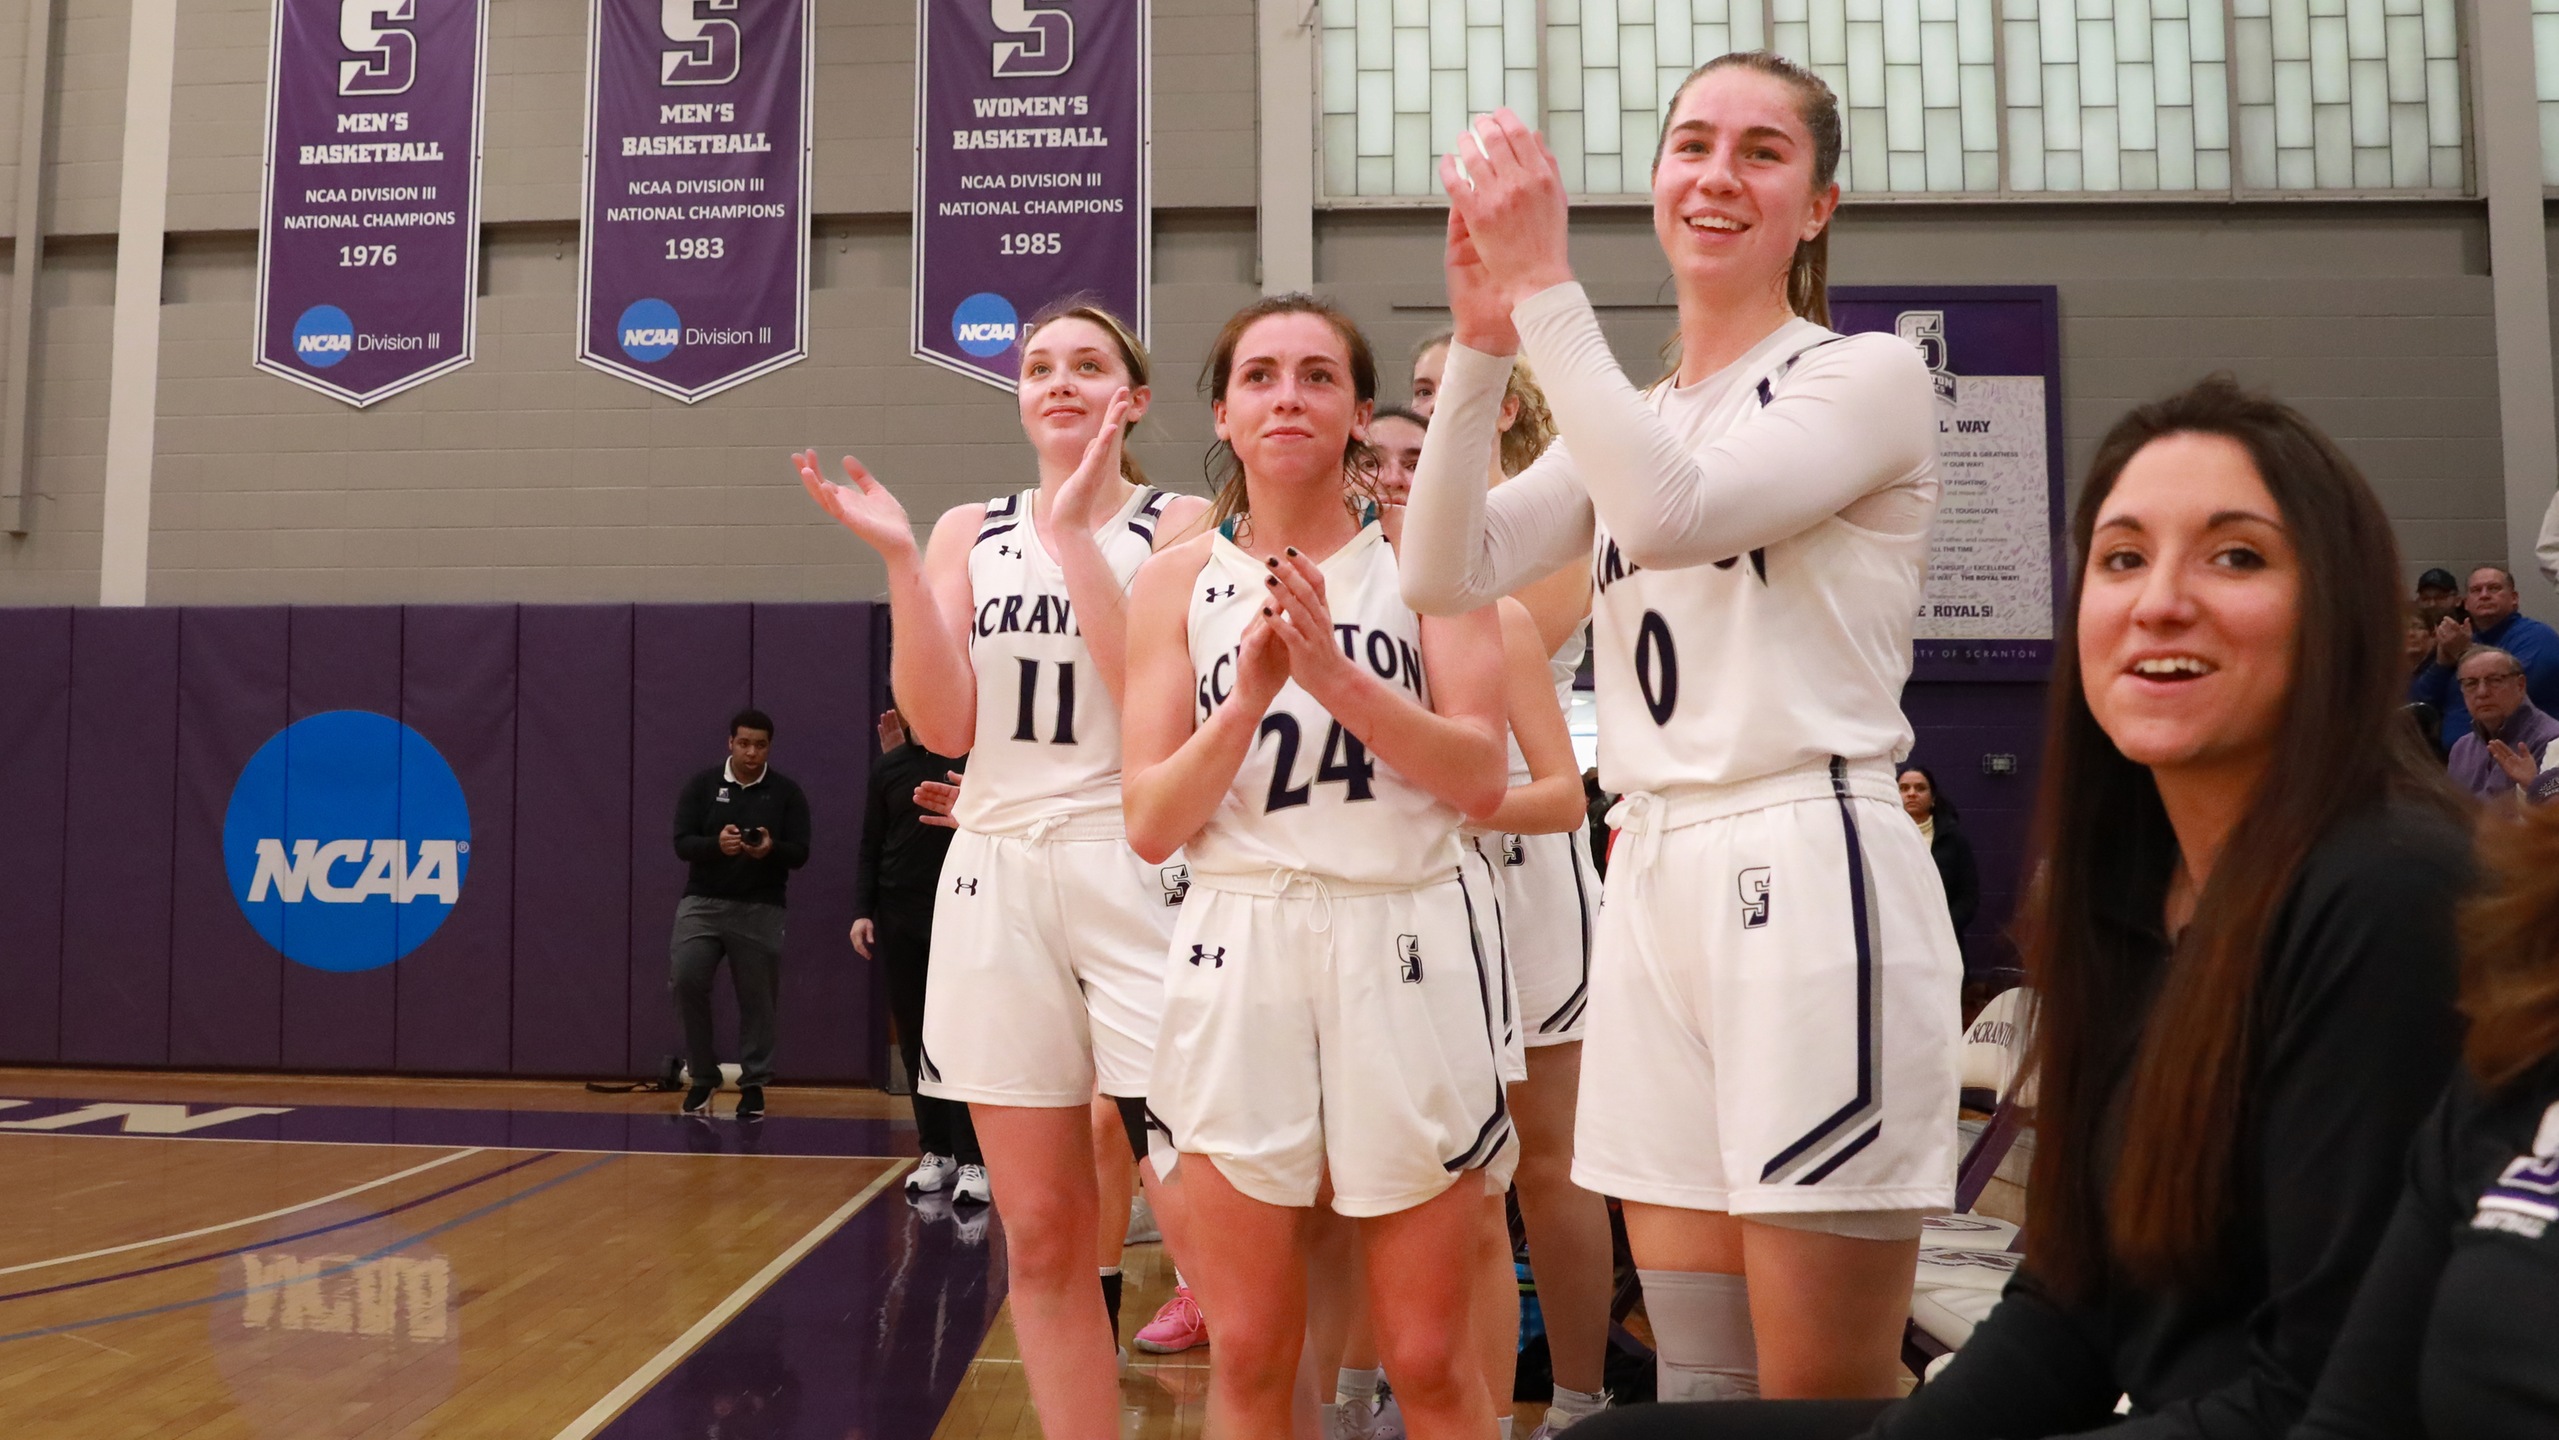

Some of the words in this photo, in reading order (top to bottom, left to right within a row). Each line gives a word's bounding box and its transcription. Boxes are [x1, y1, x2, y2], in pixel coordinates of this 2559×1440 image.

[660, 103, 735, 124] MEN'S
[973, 95, 1088, 118] WOMEN'S
[337, 112, 409, 133] MEN'S
[622, 133, 771, 157] BASKETBALL
[952, 127, 1108, 150] BASKETBALL
[300, 141, 443, 164] BASKETBALL
[628, 180, 673, 195] NCAA
[676, 179, 744, 194] DIVISION
[748, 178, 765, 192] III
[961, 174, 1006, 189] NCAA
[1010, 173, 1083, 188] DIVISION
[1086, 173, 1101, 187] III
[305, 188, 347, 203] NCAA
[351, 186, 418, 202] DIVISION
[422, 186, 436, 200] III
[607, 205, 685, 222] NATIONAL
[689, 203, 785, 221] CHAMPIONS
[939, 201, 1020, 216] NATIONAL
[1024, 199, 1124, 215] CHAMPIONS
[284, 213, 359, 230] NATIONAL
[362, 211, 456, 228] CHAMPIONS
[664, 237, 725, 260] 1983
[1000, 233, 1062, 255] 1985
[339, 244, 397, 268] 1976
[298, 333, 352, 353] NCAA
[358, 332, 424, 352] Division
[427, 332, 440, 350] III
[623, 327, 679, 347] NCAA
[686, 327, 754, 346] Division
[758, 326, 772, 344] III
[958, 323, 1016, 342] NCAA
[1956, 420, 1991, 433] WAY
[1981, 507, 1999, 515] LOVE
[1933, 605, 1993, 617] ROYALS!
[1914, 649, 1934, 658] ITY
[1942, 649, 1957, 658] OF
[1965, 649, 2036, 658] SCRANTON
[1011, 656, 1078, 746] 11
[1258, 710, 1376, 816] 24
